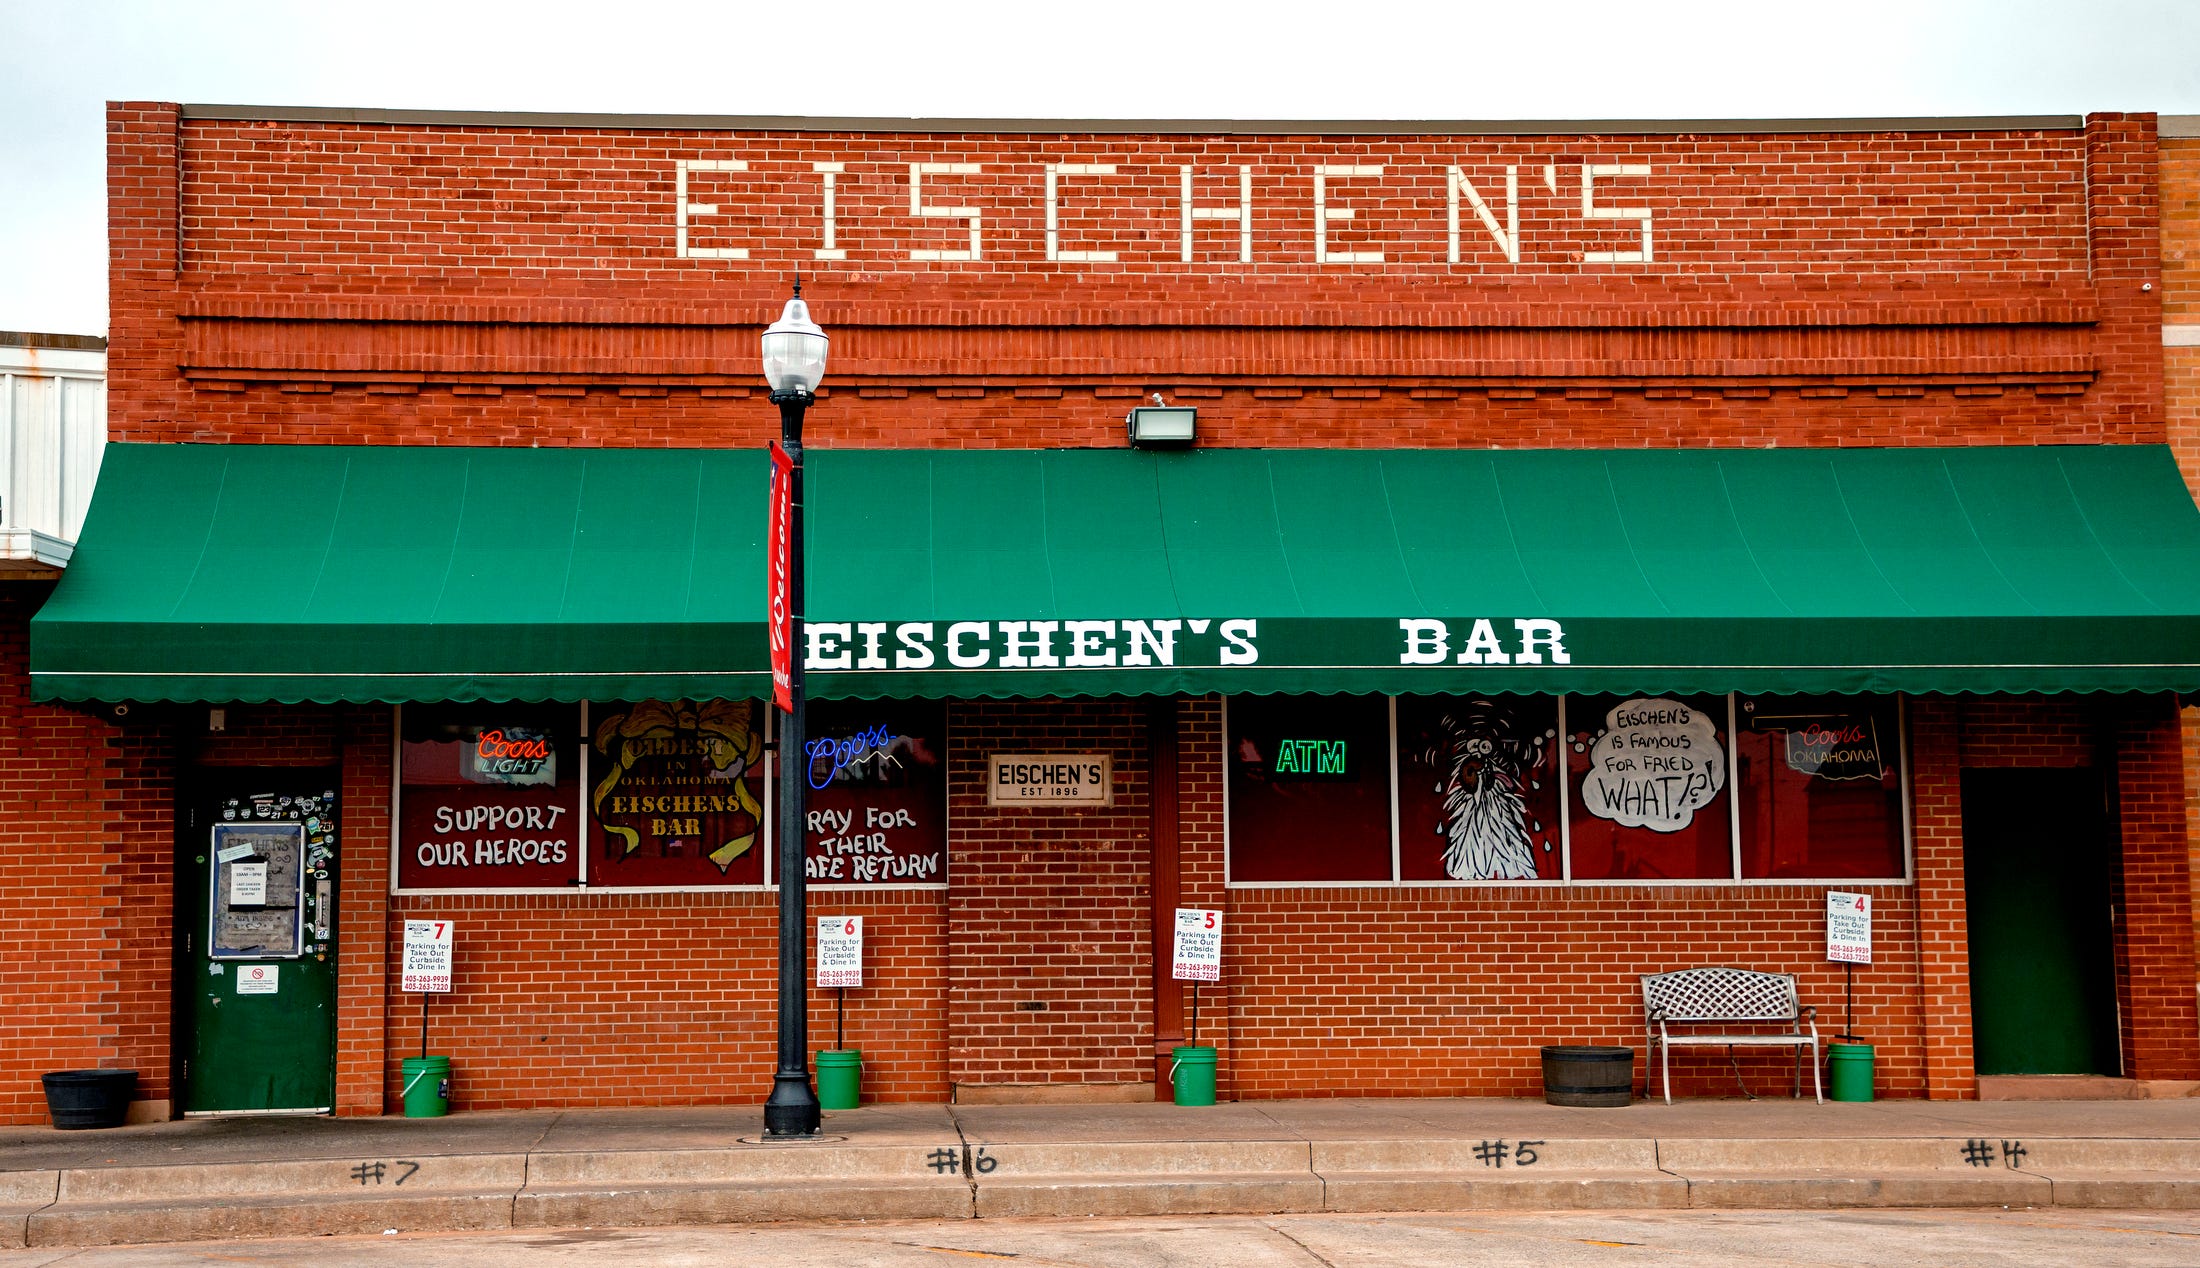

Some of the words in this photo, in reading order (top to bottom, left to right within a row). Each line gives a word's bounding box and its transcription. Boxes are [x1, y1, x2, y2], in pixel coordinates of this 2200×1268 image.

[676, 159, 1653, 263] EISCHEN'S
[772, 473, 788, 652] Welcome
[803, 619, 1259, 669] EISCHEN'S
[1399, 618, 1571, 664] BAR
[1616, 708, 1691, 728] EISCHEN'S
[1611, 735, 1624, 749] IS
[1629, 733, 1691, 749] FAMOUS
[1799, 723, 1866, 746] Coors
[478, 730, 549, 759] Coors
[629, 737, 723, 756] OLDEST
[805, 723, 896, 790] Coors
[1276, 739, 1345, 773] ATM
[1605, 756, 1637, 773] FOR
[1643, 755, 1694, 773] FRIED
[1793, 749, 1876, 764] OKLAHOMA
[481, 759, 544, 774] LIGHT
[666, 761, 686, 770] IN
[998, 763, 1101, 785] EISCHEN'S
[620, 775, 731, 786] OKLAHOMA
[1051, 787, 1078, 796] 1896
[611, 794, 742, 814] EISCHENS
[434, 805, 567, 834] SUPPORT
[651, 818, 702, 836] BAR
[806, 808, 853, 835] RAY
[866, 807, 917, 829] FOR
[417, 841, 469, 867] OUR
[474, 838, 567, 866] HEROES
[819, 832, 893, 856] THEIR
[806, 855, 845, 879] AFE
[852, 852, 939, 881] RETURN
[1855, 896, 1865, 912] 4
[1204, 912, 1215, 929] 5
[1830, 913, 1857, 922] Parking
[1859, 915, 1869, 923] for
[434, 922, 446, 940] 7
[844, 918, 855, 936] 6
[1177, 930, 1206, 939] Parking
[1834, 926, 1865, 936] Curbside
[1841, 933, 1857, 941] Dine
[406, 942, 436, 950] Parking
[430, 949, 445, 957] Out
[1181, 944, 1214, 953] Curbside
[1188, 951, 1205, 959] Dine
[820, 970, 860, 978] 405-263-9939
[1175, 971, 1218, 979] 405-263-7220
[1176, 962, 1218, 972] 405-263-9939
[405, 975, 449, 983] 405-263-9939
[405, 983, 449, 991] 405-263-7220
[820, 978, 860, 986] 405-263-7220
[1472, 1139, 1545, 1168] #5
